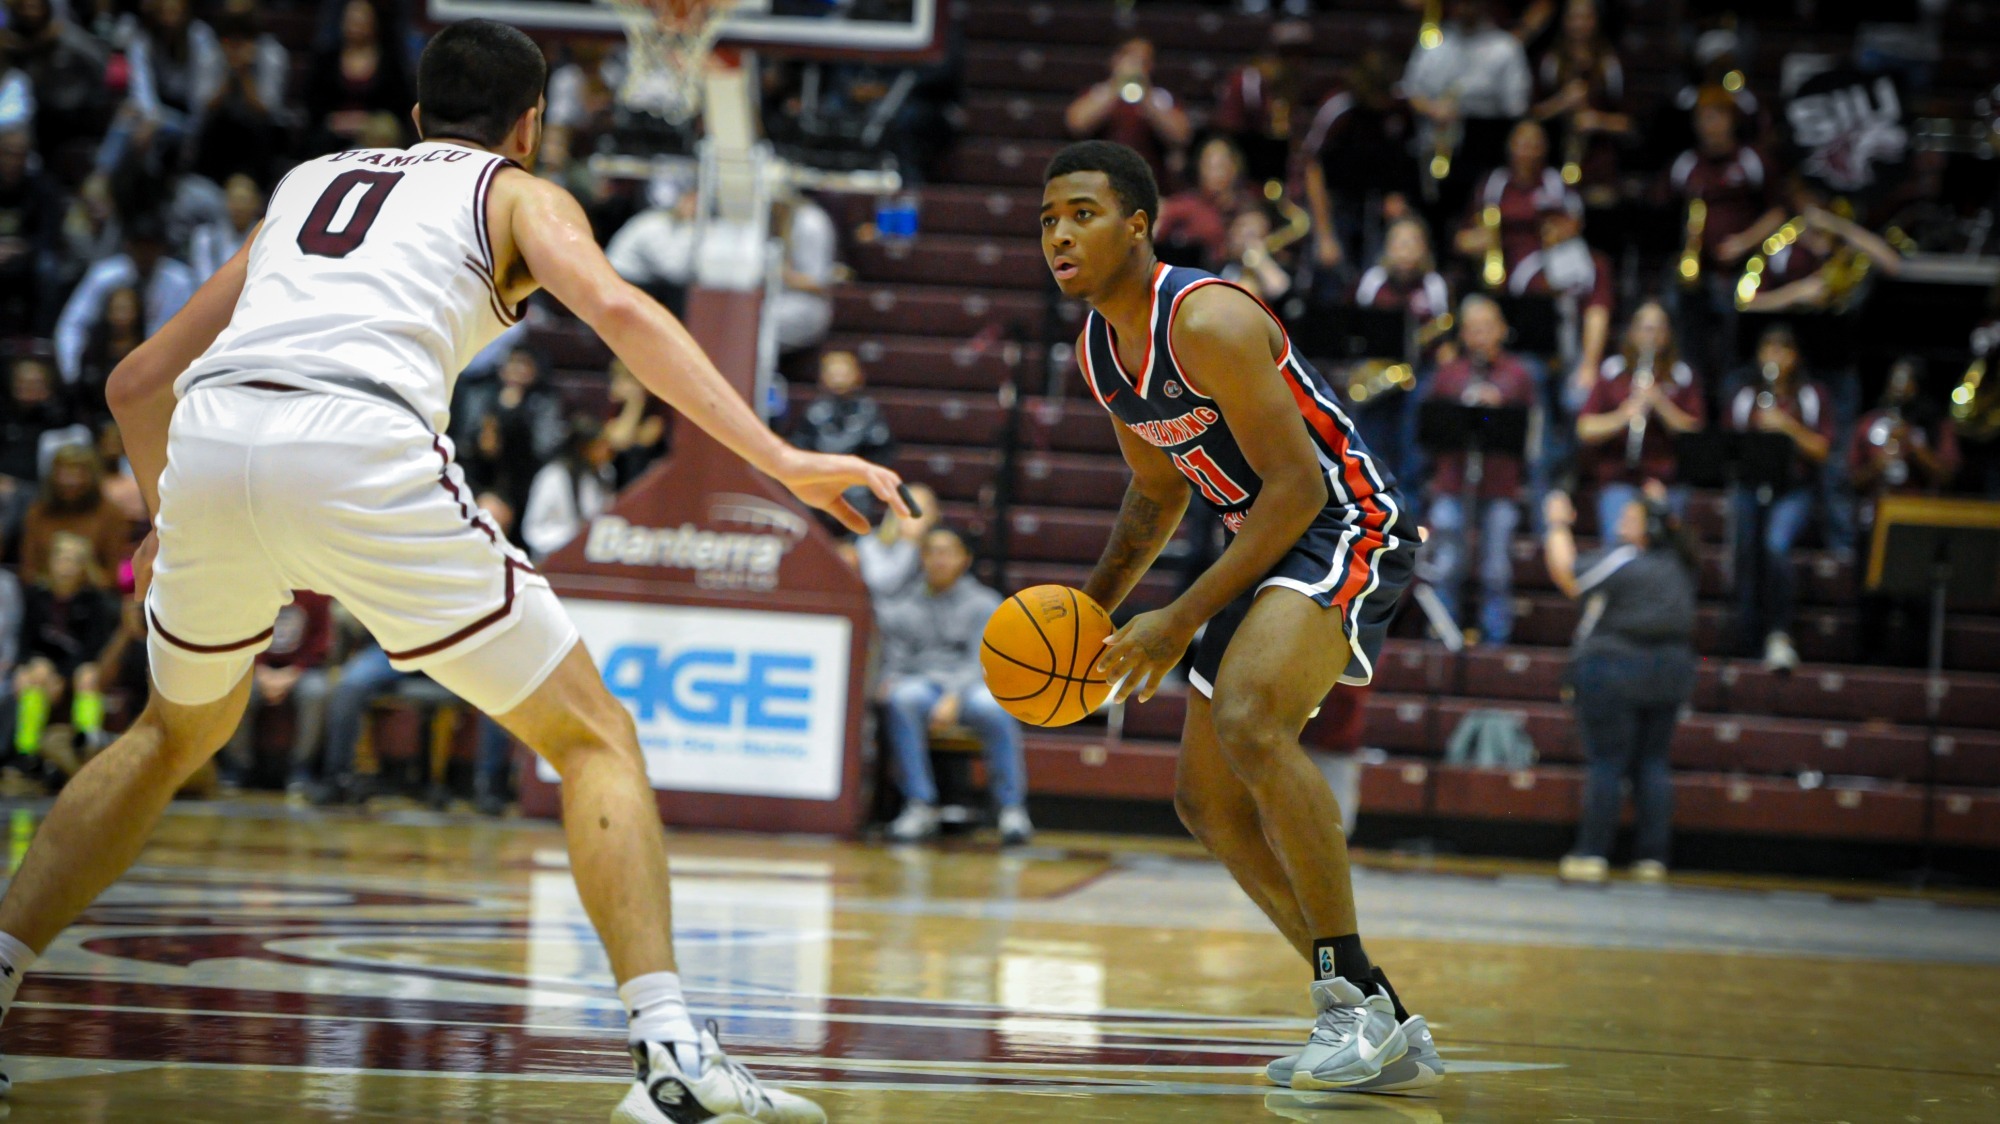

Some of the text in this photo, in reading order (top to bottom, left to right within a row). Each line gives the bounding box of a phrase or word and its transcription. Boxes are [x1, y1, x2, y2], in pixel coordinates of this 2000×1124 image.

[1785, 74, 1901, 147] SIU
[328, 149, 472, 167] D'AMICO
[296, 168, 406, 259] 0
[1126, 406, 1219, 447] CREAMING
[1170, 444, 1250, 506] 11
[584, 515, 783, 573] Banterra
[600, 644, 813, 730] AGE
